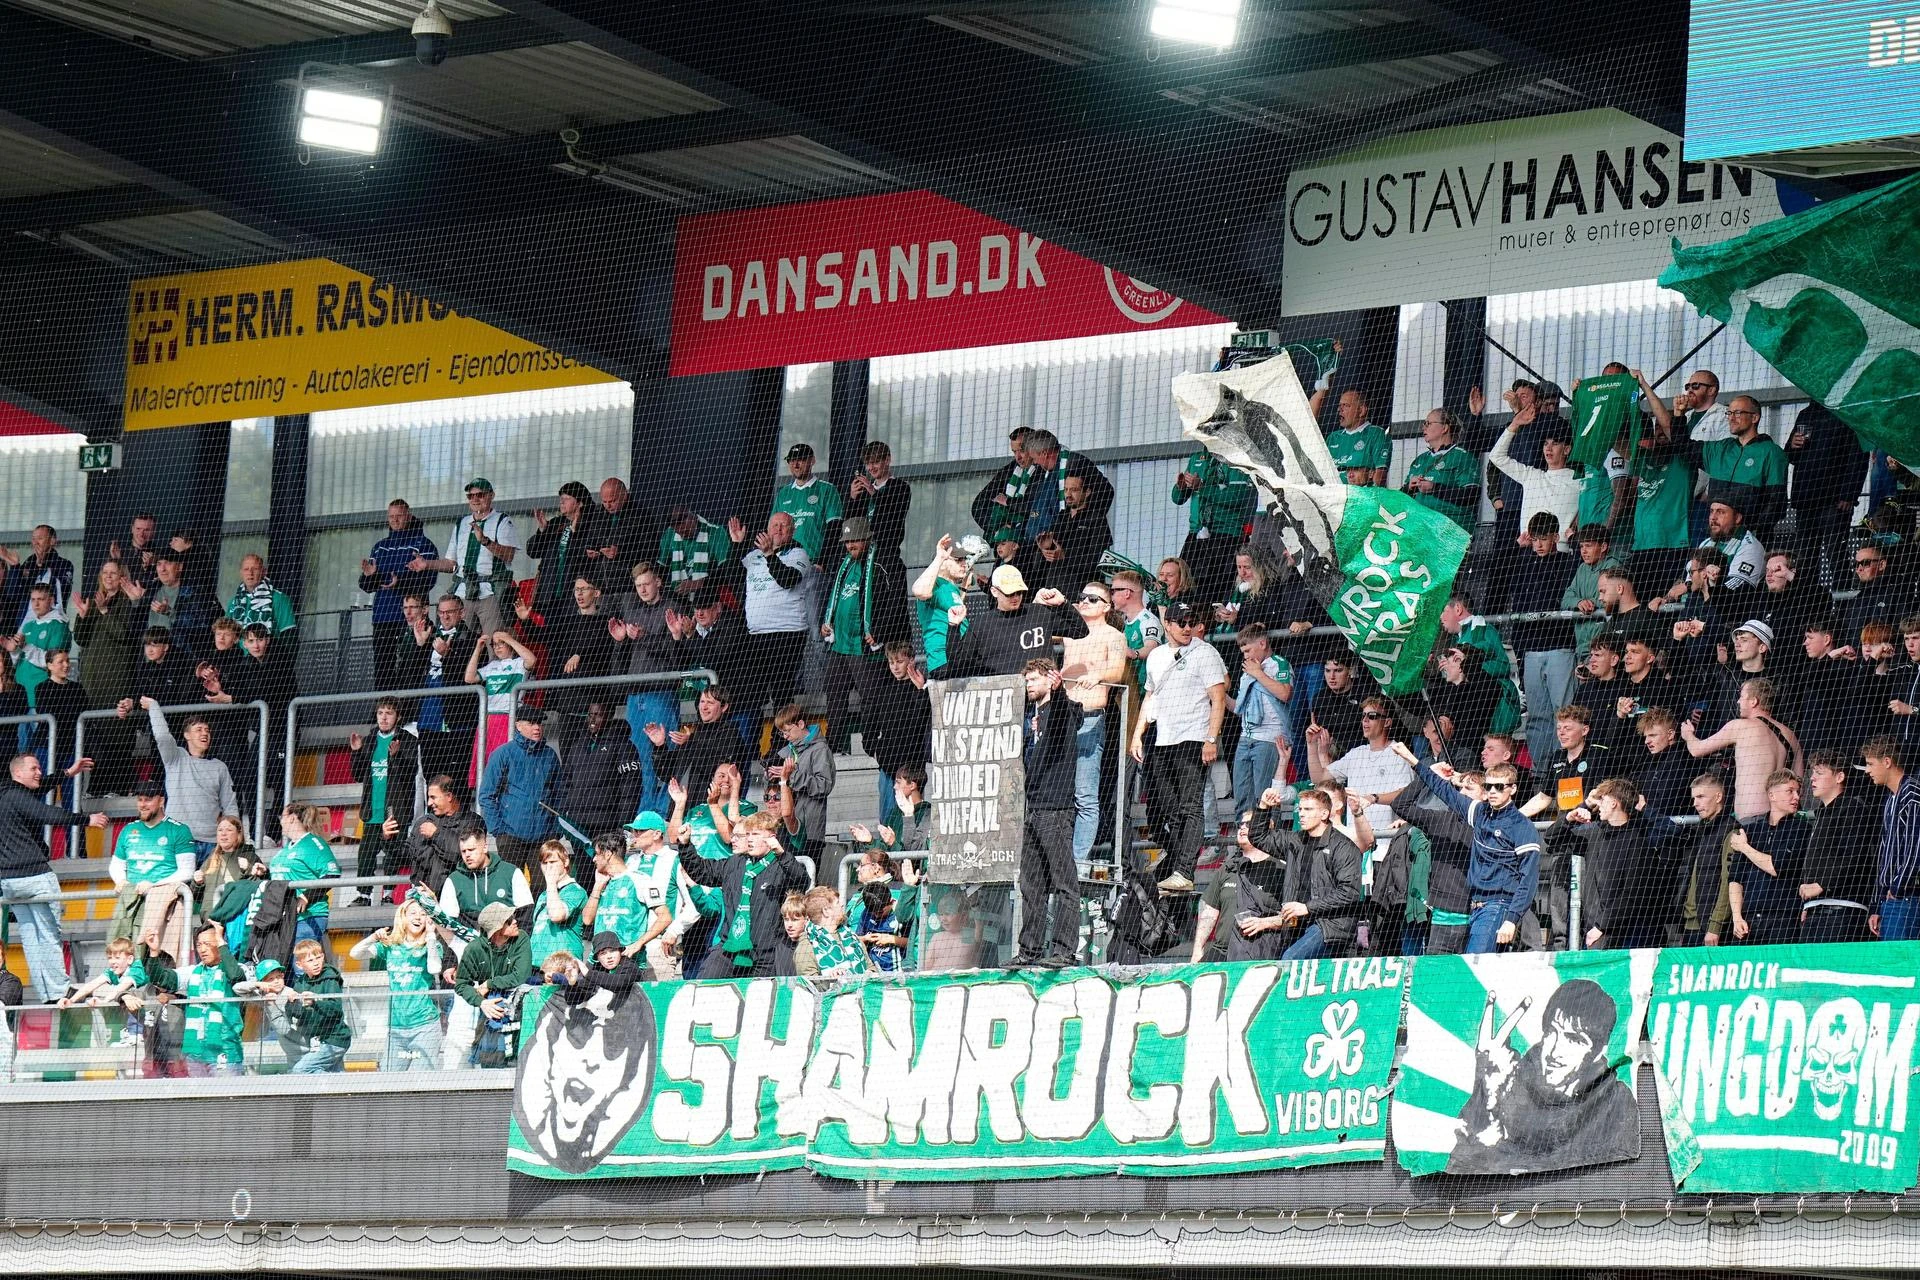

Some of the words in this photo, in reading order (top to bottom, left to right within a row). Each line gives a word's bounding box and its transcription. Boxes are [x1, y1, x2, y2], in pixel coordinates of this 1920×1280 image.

[1500, 231, 1554, 251] murer
[1565, 225, 1577, 244] &
[1587, 213, 1711, 244] entreprenør
[1720, 206, 1750, 227] a/s
[702, 233, 1046, 321] DANSAND.DK
[1123, 284, 1171, 308] GREENLI
[185, 287, 303, 349] HERM.
[130, 375, 286, 413] Malerforretning
[305, 357, 429, 394] Autolakereri
[1595, 395, 1609, 404] LUND
[1581, 405, 1602, 436] 1
[1020, 626, 1045, 650] CB
[943, 687, 1014, 726] UNITED
[956, 724, 1022, 763] STAND
[1286, 957, 1403, 1000] ULTRAS
[1668, 961, 1780, 995] SHAMROCK
[651, 964, 1281, 1146] SHAMROCK
[1275, 1085, 1380, 1135] VIBORG
[1839, 1130, 1898, 1170] 2009
